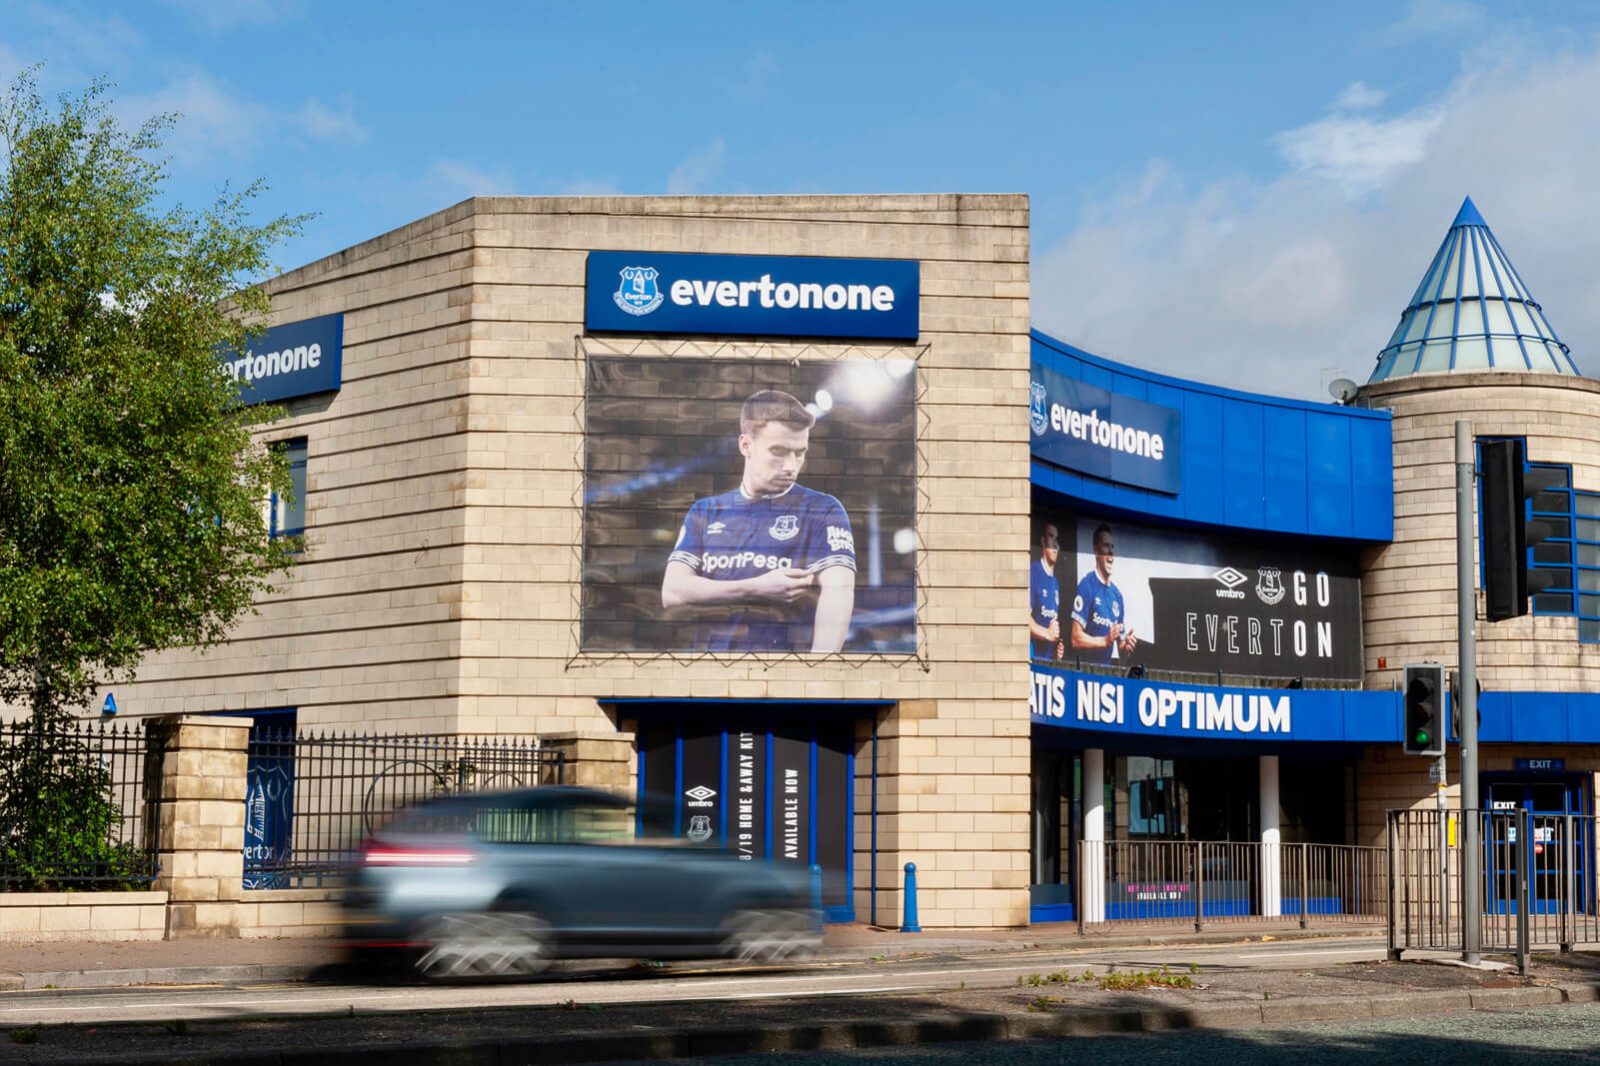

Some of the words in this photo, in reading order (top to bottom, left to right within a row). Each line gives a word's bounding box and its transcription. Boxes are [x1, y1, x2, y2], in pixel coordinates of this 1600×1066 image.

[671, 274, 895, 311] evertonone
[1050, 403, 1164, 460] evertonone
[702, 551, 792, 572] SportPesa
[1216, 588, 1246, 600] umbro
[1293, 570, 1330, 607] GO
[1186, 612, 1333, 658] EVERTON
[1077, 680, 1125, 725] NISI
[1138, 687, 1292, 733] OPTIMUM
[784, 769, 799, 793] NOW
[1529, 760, 1552, 769] EXIT
[739, 798, 753, 828] HOME
[1493, 801, 1516, 810] EXIT
[784, 798, 799, 858] AVAILABLE
